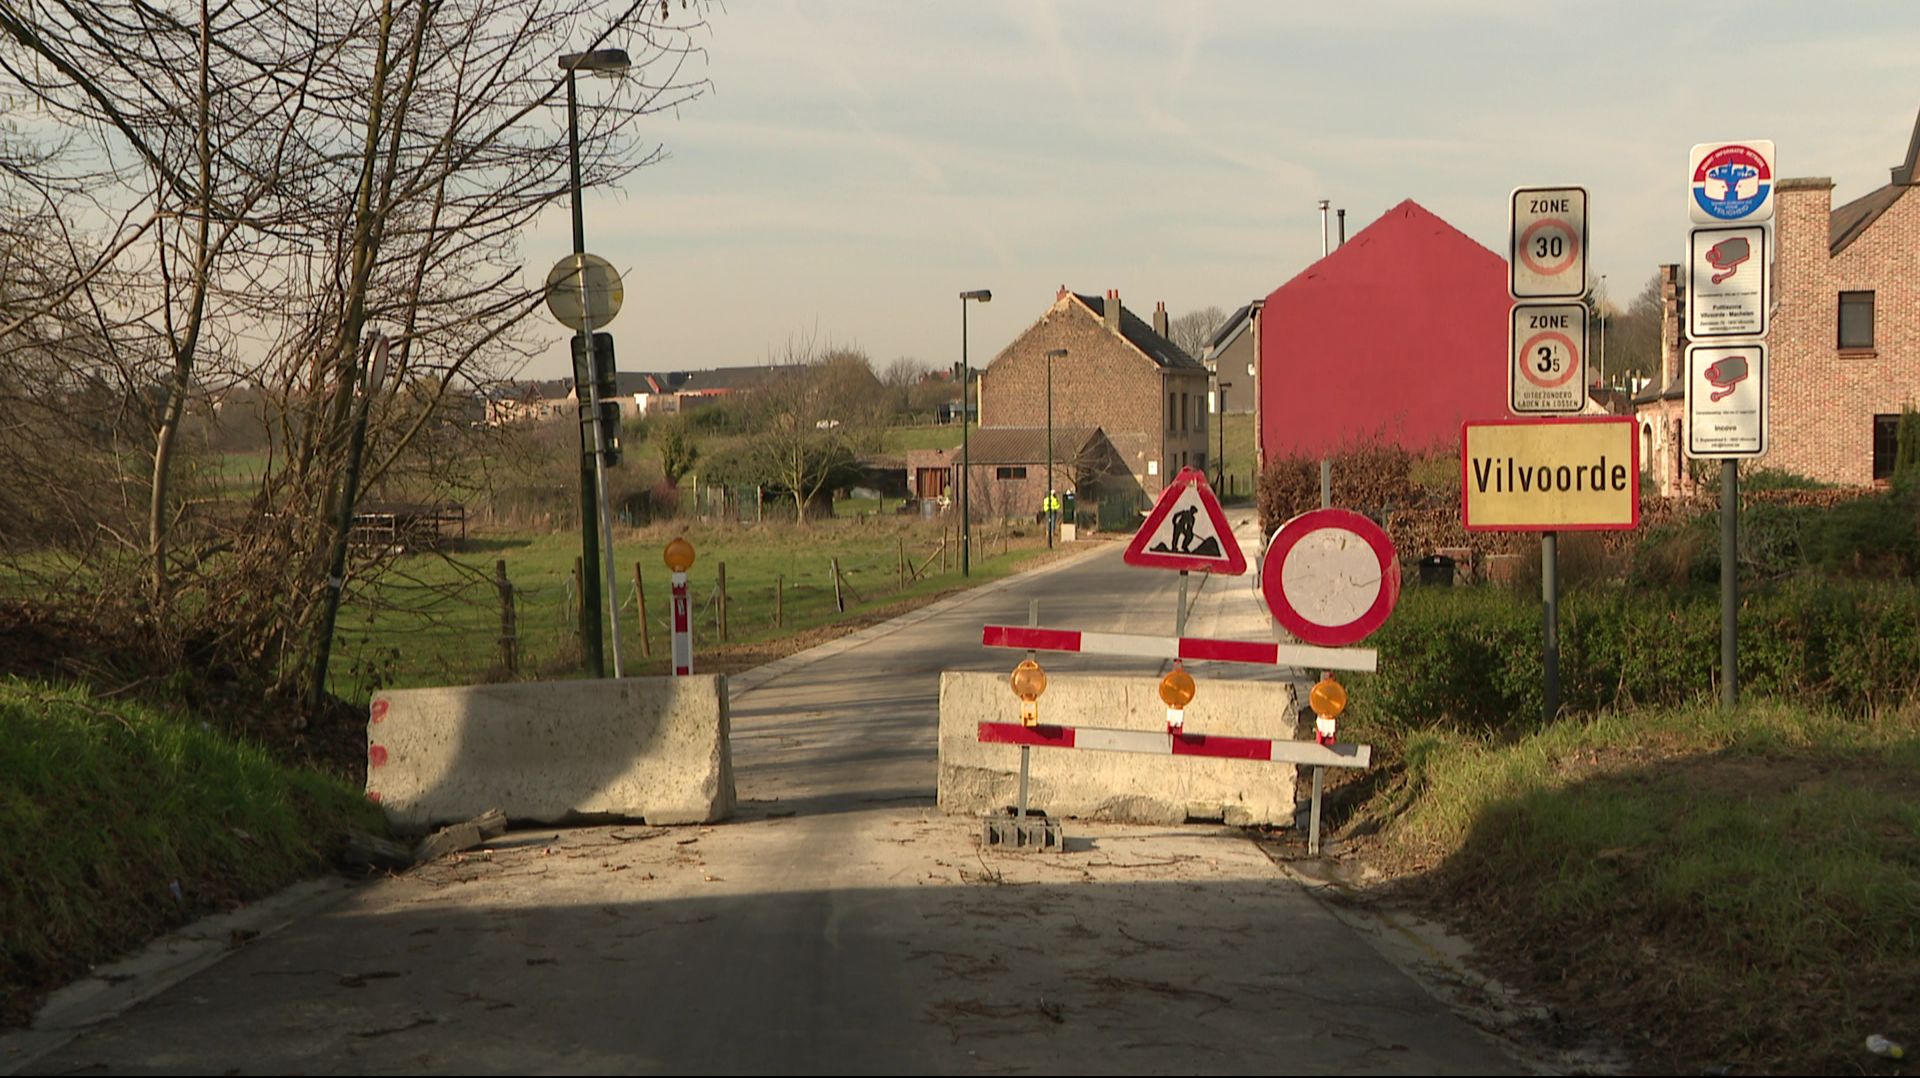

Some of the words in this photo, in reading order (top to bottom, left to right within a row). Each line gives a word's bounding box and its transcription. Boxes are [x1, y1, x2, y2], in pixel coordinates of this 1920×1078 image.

[1530, 199, 1569, 214] ZONE
[1536, 236, 1562, 258] 30
[1530, 315, 1569, 329] ZONE
[1523, 391, 1573, 399] UITGEZONDERD
[1517, 400, 1539, 408] LADEN
[1553, 400, 1578, 408] LOSSEN
[1472, 455, 1627, 493] Vilvoorde
